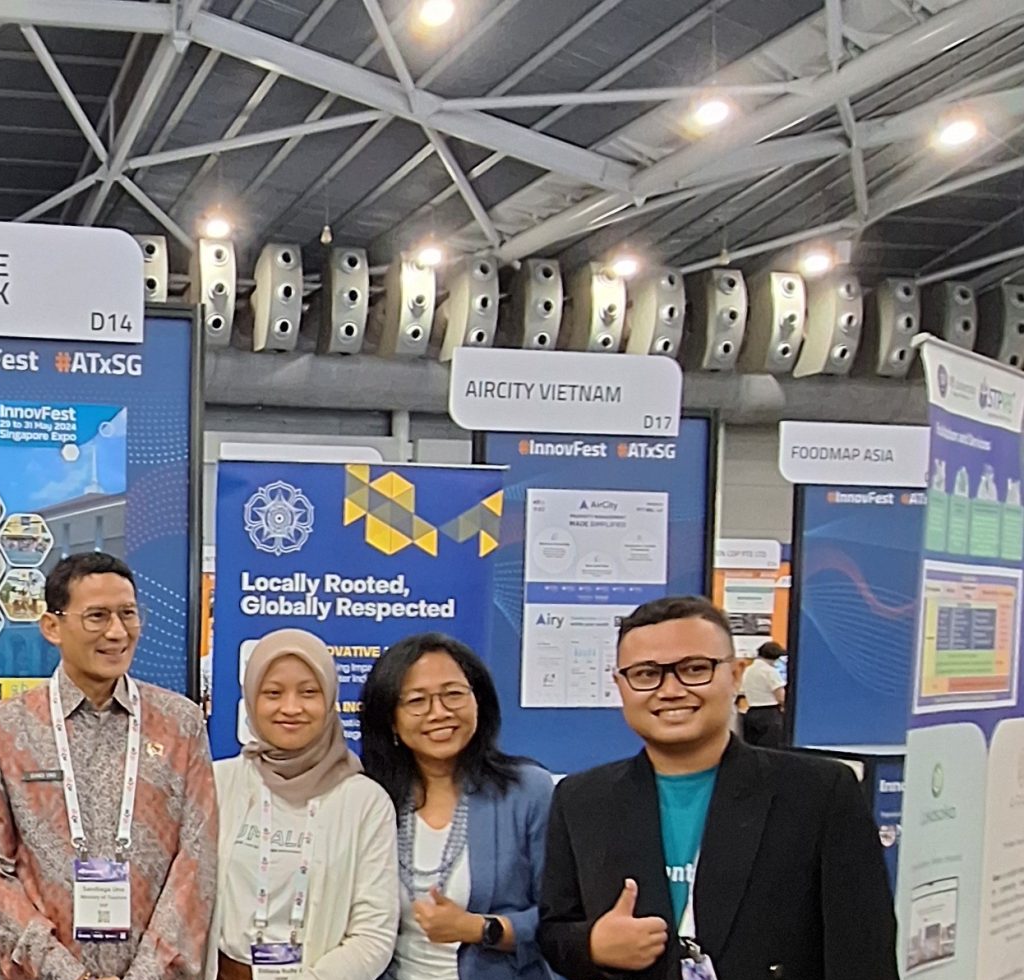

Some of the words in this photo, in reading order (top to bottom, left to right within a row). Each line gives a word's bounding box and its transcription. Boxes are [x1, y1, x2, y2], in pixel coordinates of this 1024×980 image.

[91, 312, 133, 333] D14
[55, 352, 142, 376] #ATxSG
[465, 380, 535, 400] AIRCITY
[539, 384, 621, 403] VIETNAM
[0, 404, 76, 421] InnovFest
[643, 415, 672, 430] D17
[0, 429, 49, 442] Singapore
[51, 431, 77, 443] Expo
[791, 446, 860, 461] FOODMAP
[863, 449, 894, 463] ASIA
[241, 572, 320, 597] Locally
[325, 574, 410, 597] Rooted,
[240, 595, 331, 621] Globally
[336, 598, 455, 622] Respected
[536, 613, 565, 628] Airy
